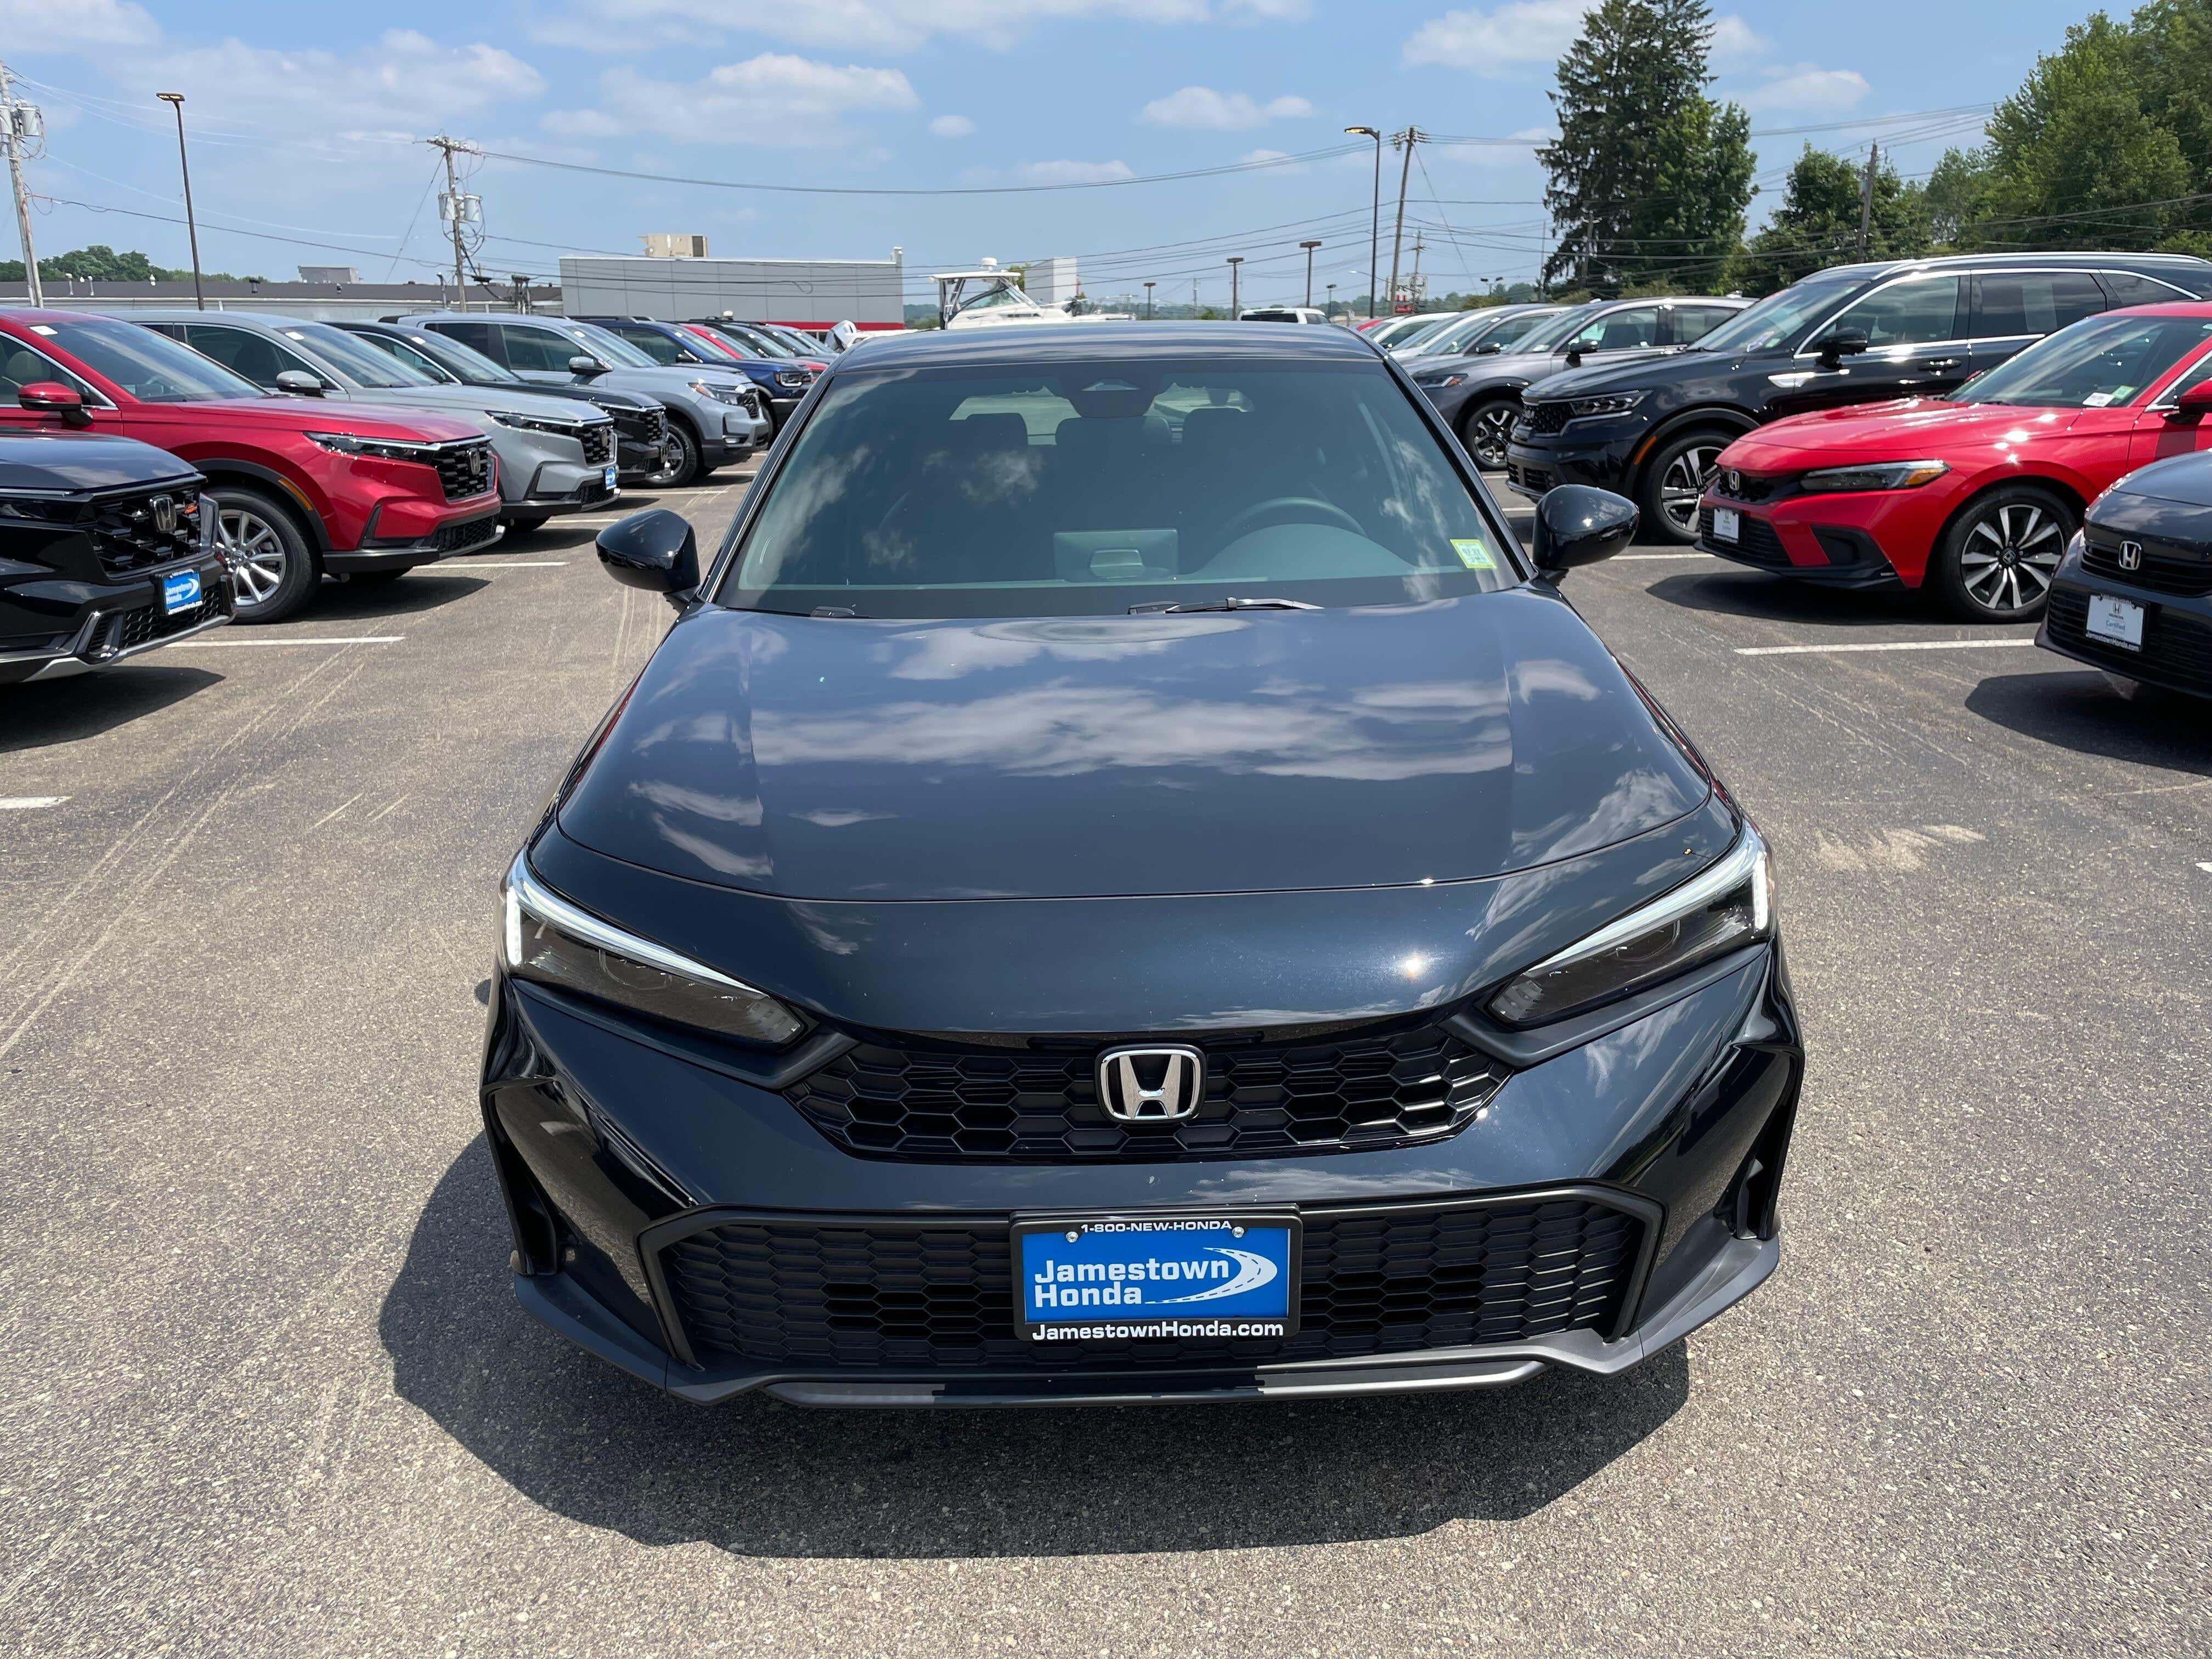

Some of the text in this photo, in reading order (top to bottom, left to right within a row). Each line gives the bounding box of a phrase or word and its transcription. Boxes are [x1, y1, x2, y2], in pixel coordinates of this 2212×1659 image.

[1081, 1220, 1232, 1233] 1-800-NEW-HONDA
[1034, 1258, 1229, 1284] Jamestown
[1034, 1282, 1142, 1307] Honda
[1032, 1320, 1284, 1341] JamestownHonda.com
